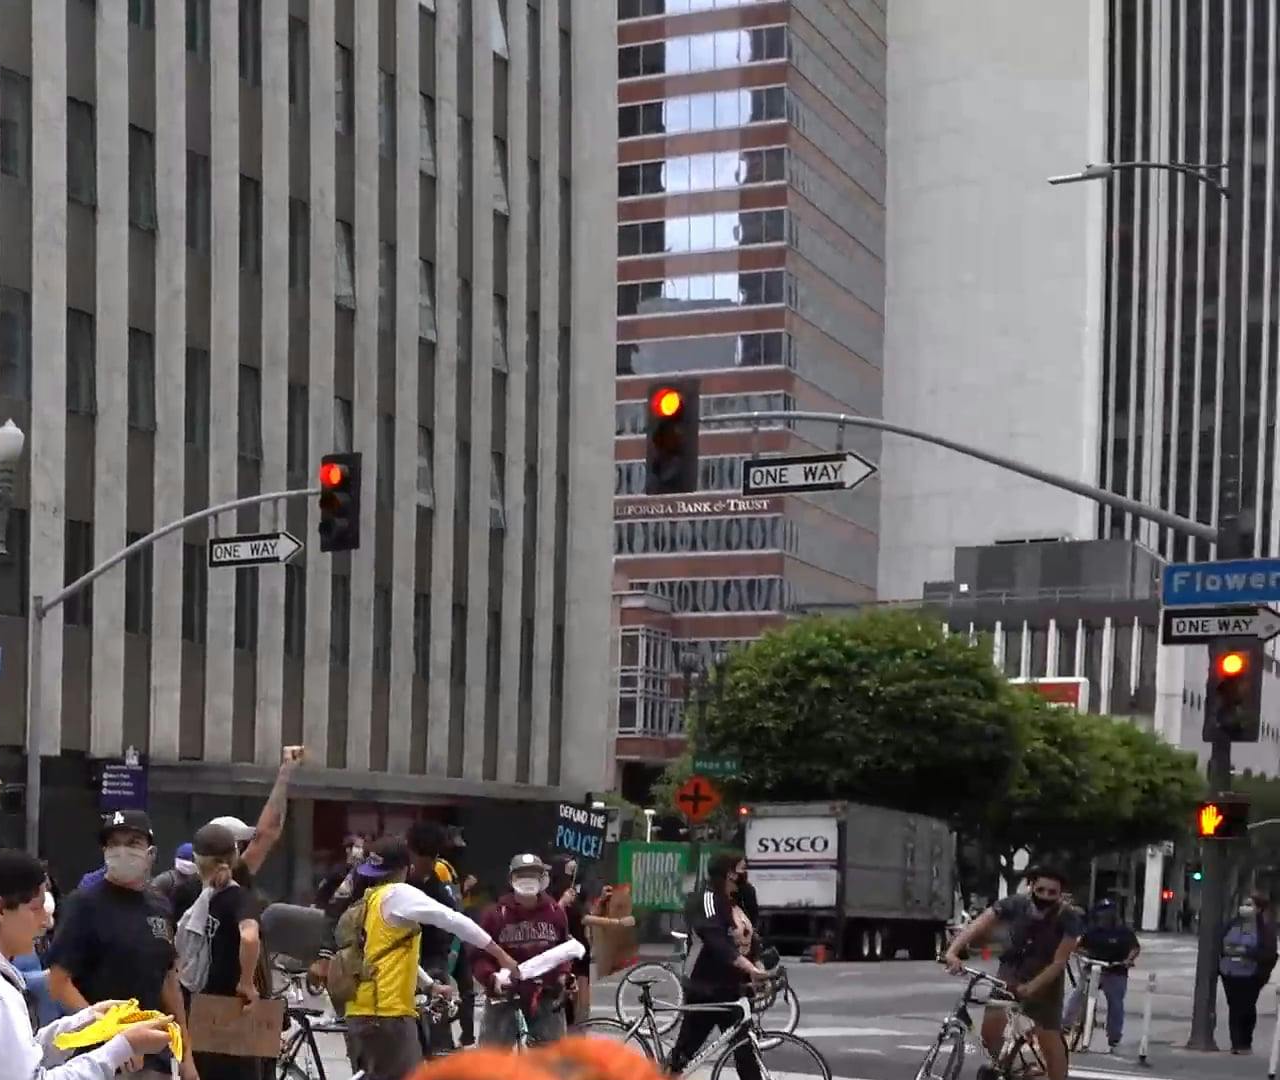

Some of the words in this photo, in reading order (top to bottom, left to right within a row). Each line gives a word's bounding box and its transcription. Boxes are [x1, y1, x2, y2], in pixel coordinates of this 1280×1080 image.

[752, 470, 789, 485] ONE
[803, 463, 843, 482] WAY
[616, 503, 673, 516] LIFORNIA
[214, 545, 241, 560] ONE
[250, 542, 277, 556] WAY
[1173, 570, 1280, 593] Flower
[1175, 619, 1209, 633] ONE
[1217, 618, 1253, 631] WAY
[560, 804, 588, 824] DEFUND
[556, 825, 603, 859] POLICE!
[757, 836, 829, 853] SYSCO
